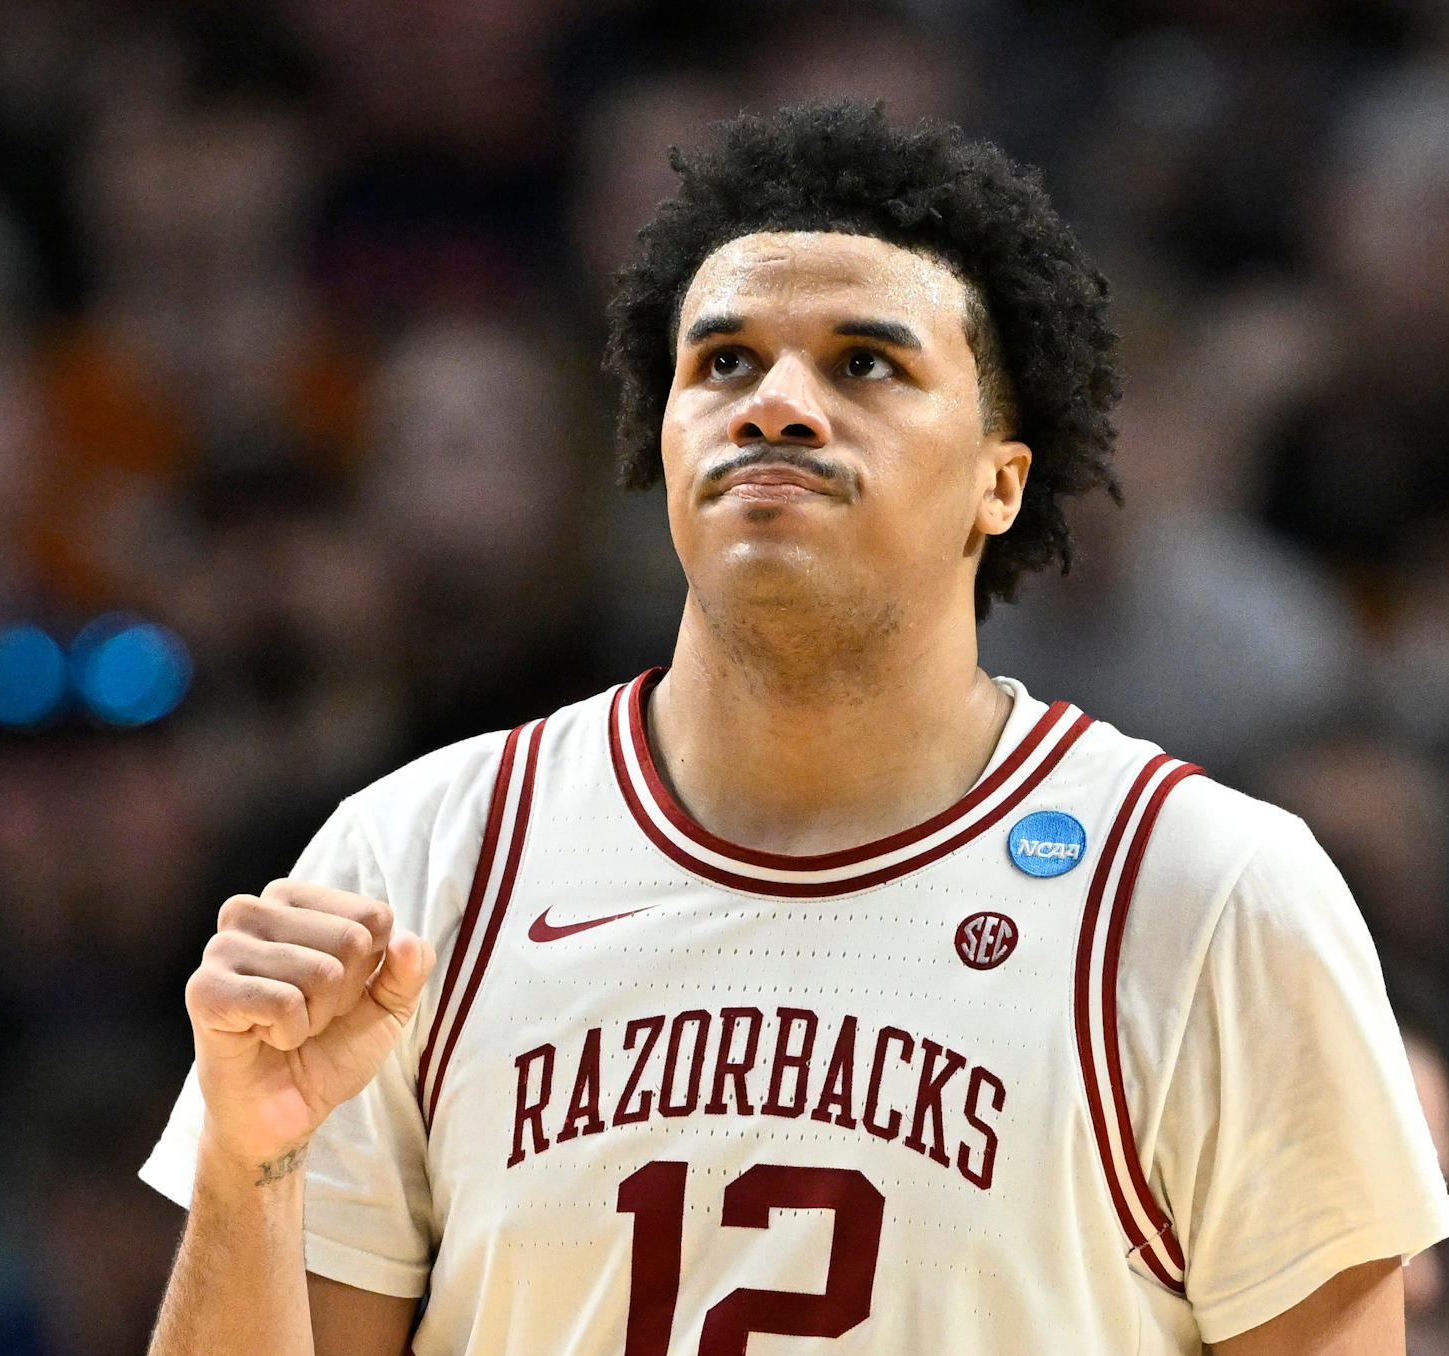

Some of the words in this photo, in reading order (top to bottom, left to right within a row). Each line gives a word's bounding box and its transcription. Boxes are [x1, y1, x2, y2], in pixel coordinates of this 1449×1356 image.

[1016, 838, 1081, 860] NCAA
[960, 915, 1013, 964] SEC
[507, 1006, 1006, 1190] RAZORBACKS
